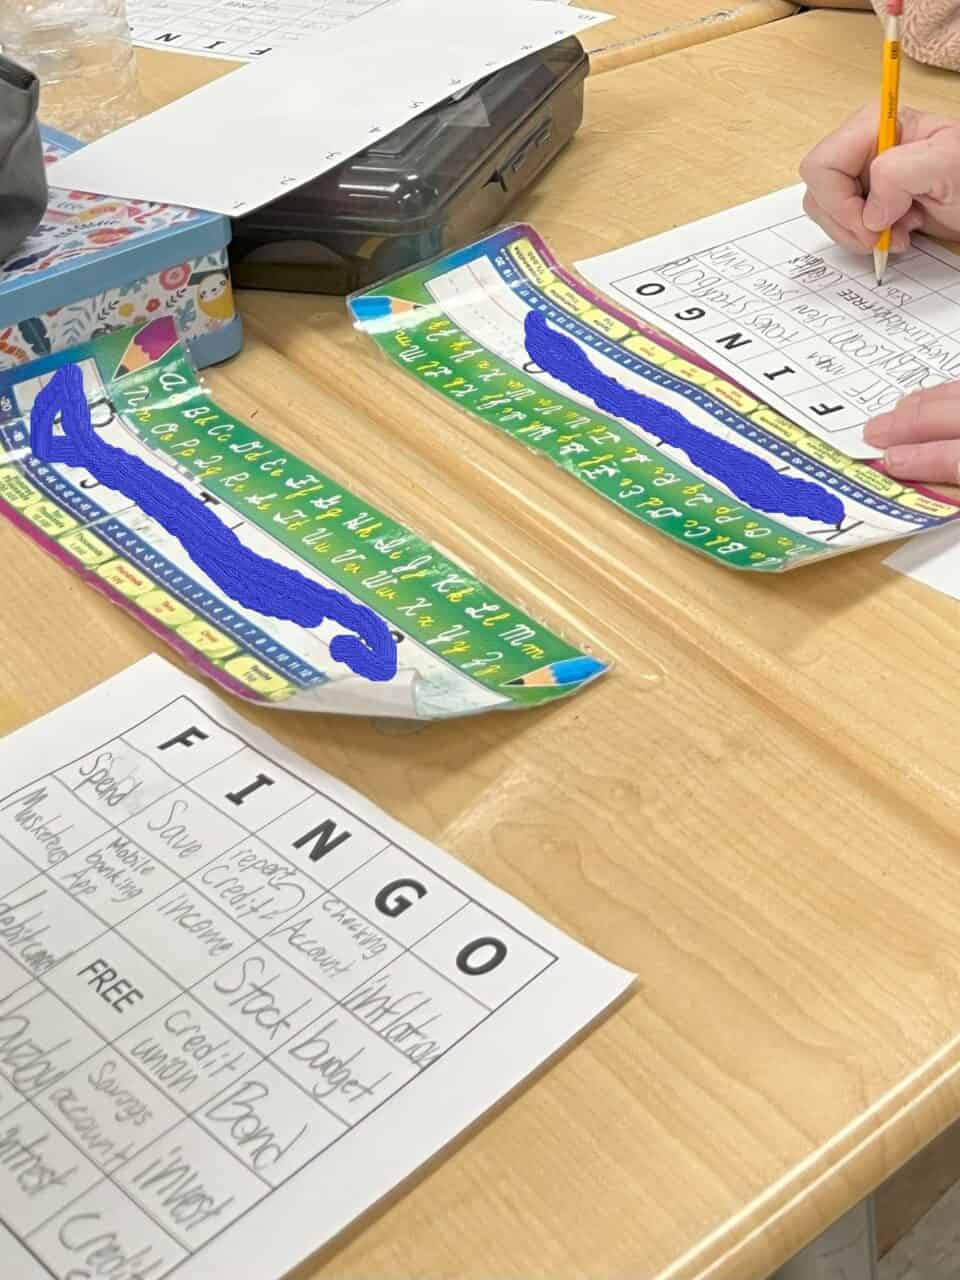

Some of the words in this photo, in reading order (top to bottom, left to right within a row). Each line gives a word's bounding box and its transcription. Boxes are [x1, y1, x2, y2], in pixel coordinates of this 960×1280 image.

[154, 32, 182, 44] N
[249, 47, 273, 57] F
[636, 283, 666, 297] O
[837, 287, 873, 312] FREE
[674, 307, 706, 321] G
[716, 332, 753, 351] N
[763, 365, 796, 381] I
[809, 403, 845, 417] F
[498, 623, 545, 659] Mm
[156, 724, 210, 752] F
[224, 772, 276, 807] I
[291, 818, 353, 863] N
[374, 877, 428, 919] G
[455, 936, 508, 977] O
[76, 958, 145, 1014] FREE
